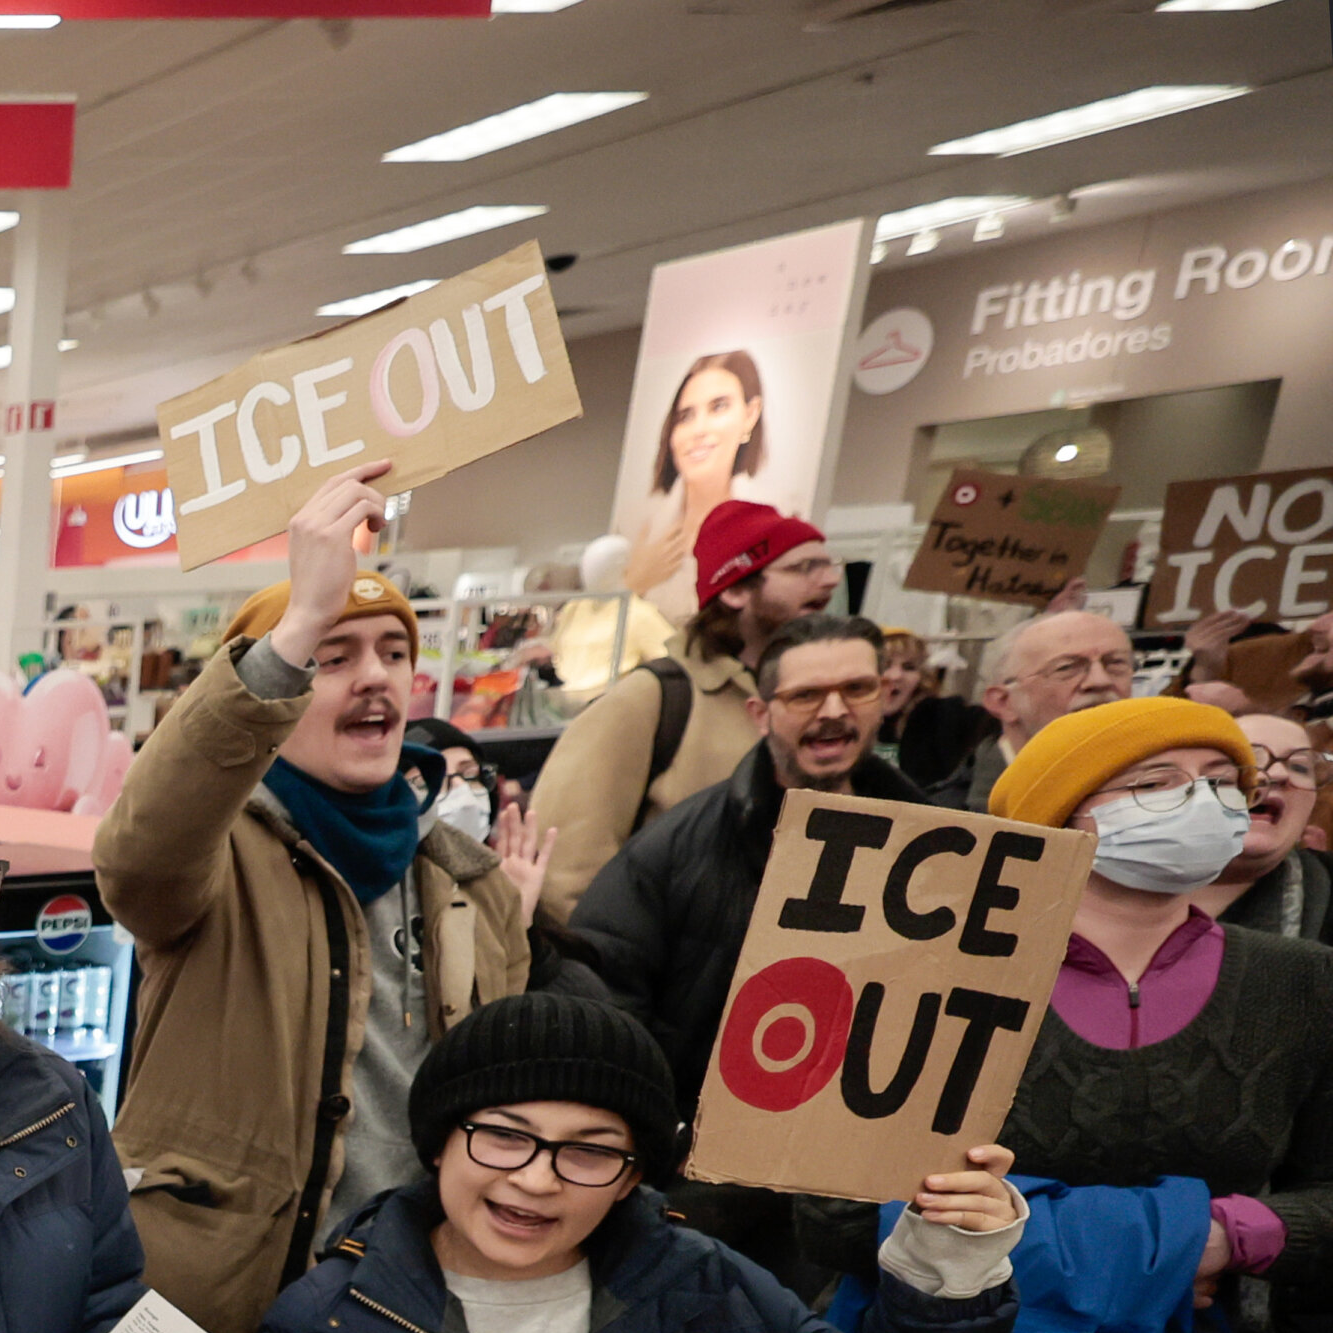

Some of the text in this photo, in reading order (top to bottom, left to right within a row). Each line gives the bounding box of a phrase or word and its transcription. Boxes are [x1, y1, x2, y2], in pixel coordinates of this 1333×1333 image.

[970, 267, 1157, 336] Fitting
[962, 321, 1172, 380] Probadores
[170, 272, 548, 516] ICE OUT
[931, 520, 1043, 567] Together
[1192, 477, 1333, 548] NO
[1156, 542, 1333, 624] ICE
[777, 807, 1046, 957] ICE
[41, 916, 89, 932] PEPSI
[719, 956, 1031, 1136] OUT
